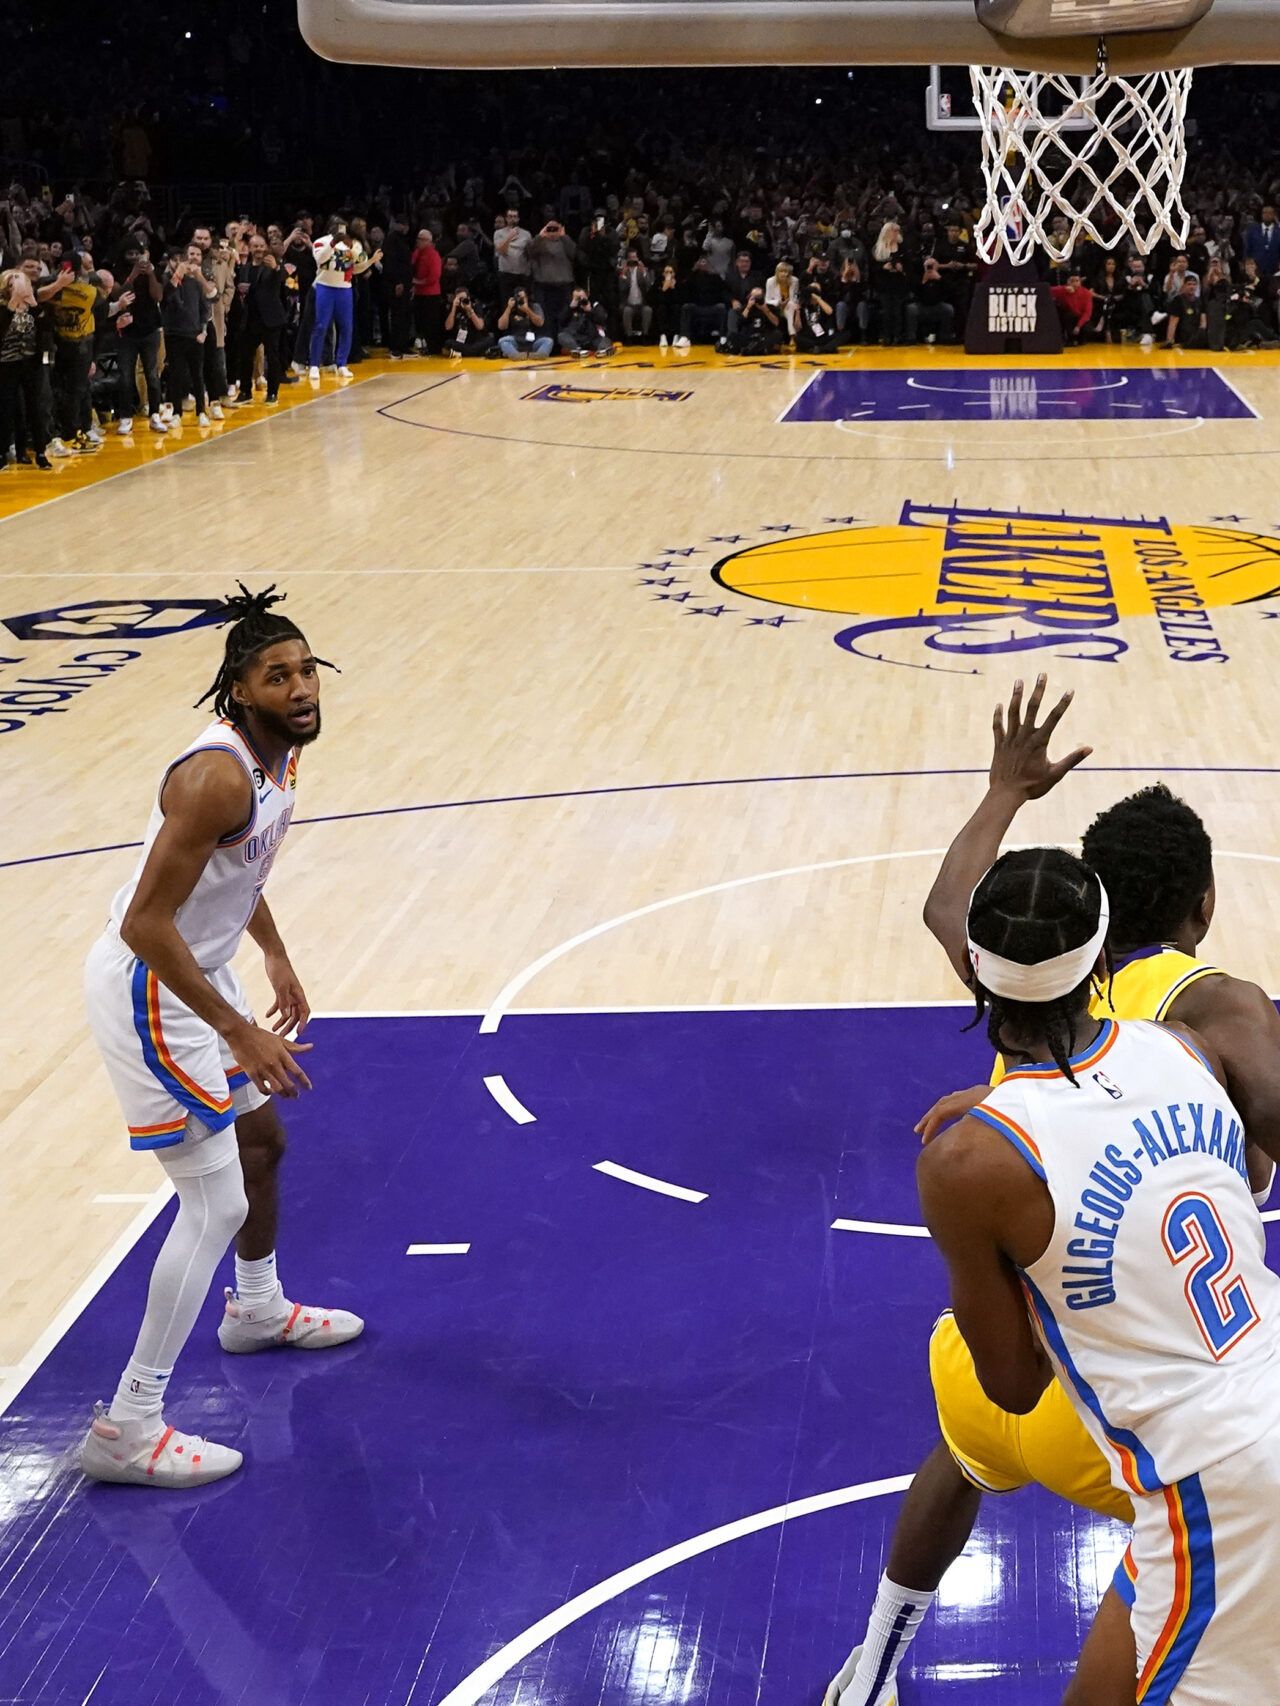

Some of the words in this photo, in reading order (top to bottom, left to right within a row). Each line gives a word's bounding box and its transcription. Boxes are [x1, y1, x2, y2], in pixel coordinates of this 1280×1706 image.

[988, 294, 1037, 317] BLACK
[988, 317, 1036, 332] HISTORY
[833, 498, 1173, 675] LAKERS
[1133, 538, 1189, 568] LOS
[1141, 567, 1231, 664] ANGELES
[1062, 1102, 1248, 1311] GILGEOUS-ALEXAND
[1160, 1190, 1261, 1362] 2
